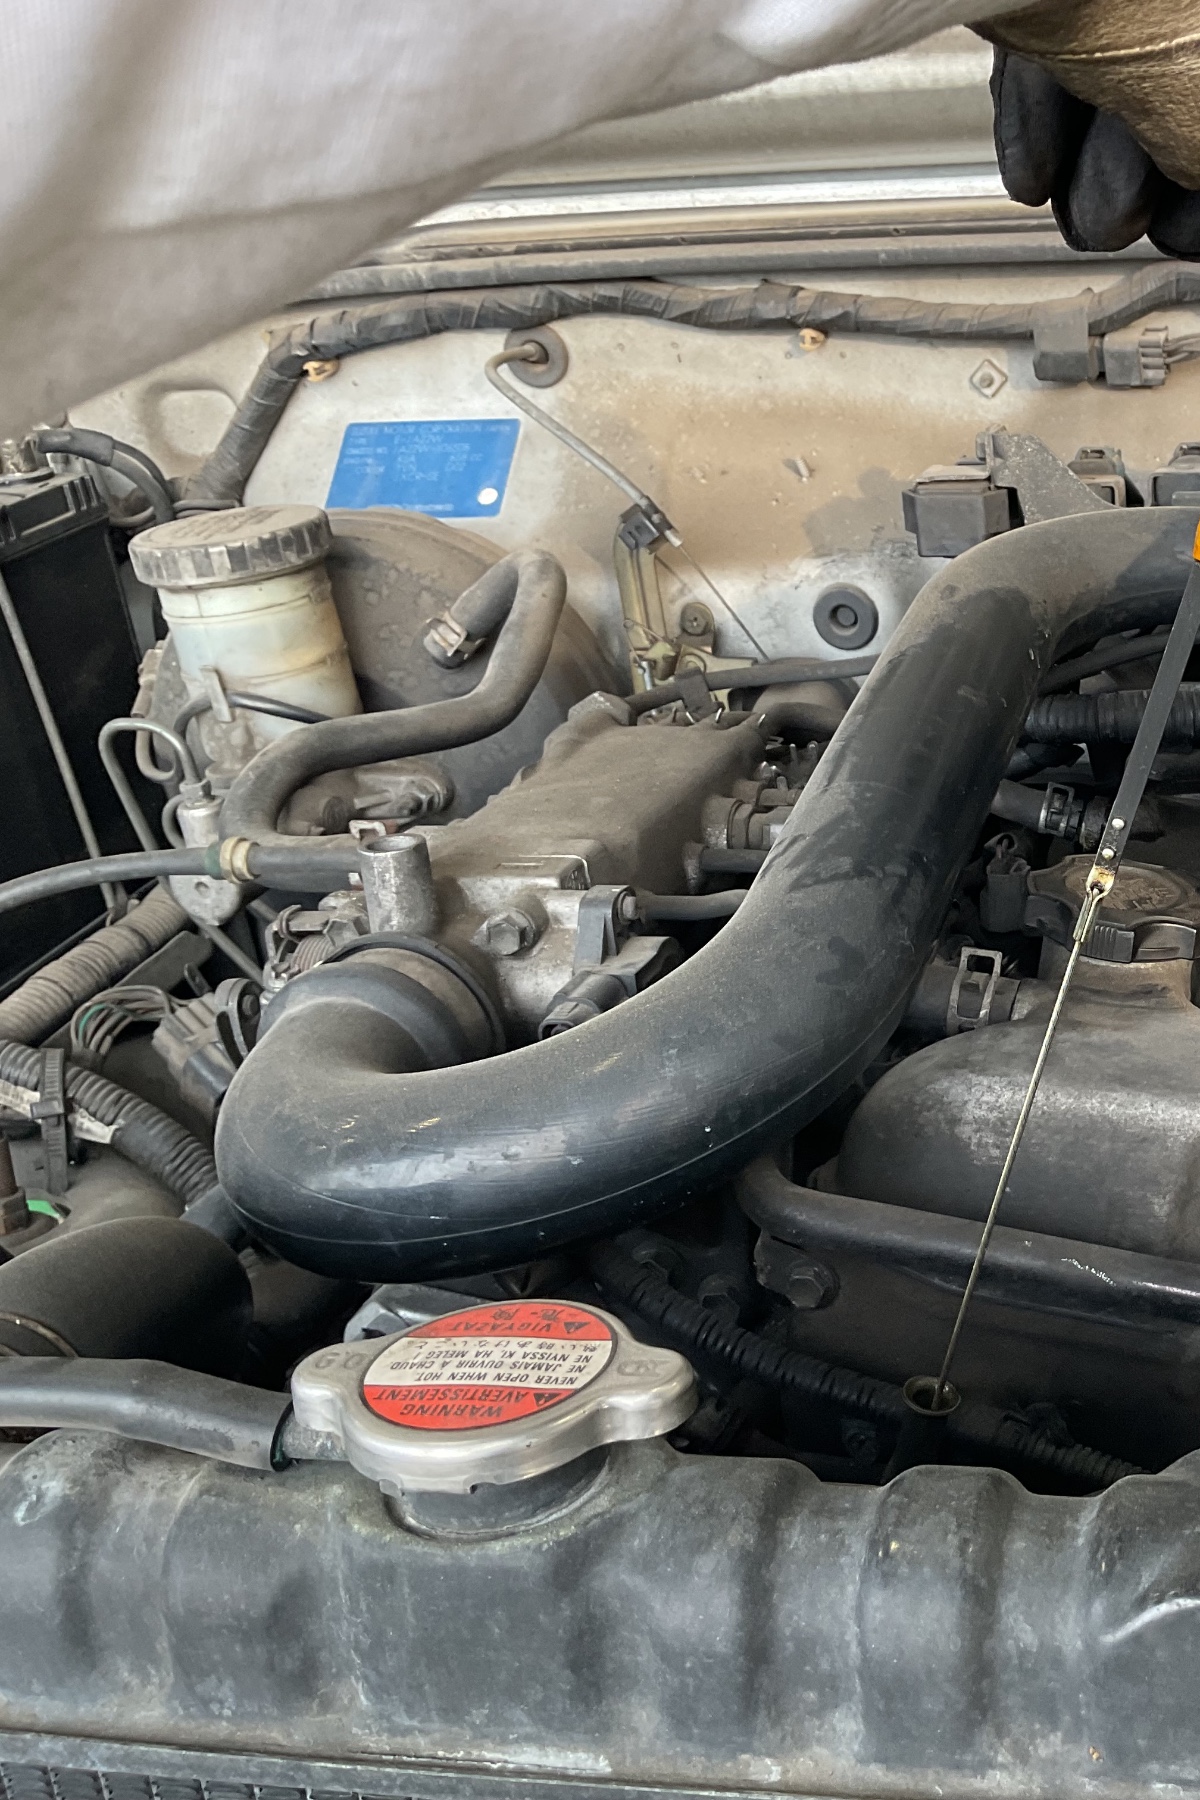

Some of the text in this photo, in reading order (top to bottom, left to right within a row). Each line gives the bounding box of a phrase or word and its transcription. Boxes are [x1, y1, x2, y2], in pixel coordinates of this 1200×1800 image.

[425, 1350, 468, 1360] MELEG
[474, 1350, 492, 1359] HA
[522, 1351, 570, 1362] NYISSA
[574, 1354, 593, 1364] NE
[390, 1359, 587, 1374] NE JAMAIS OUVRIR À CHAUD.
[414, 1371, 579, 1386] NEVER OPEN WHEN HOT.
[373, 1388, 530, 1404] AVERTISSEMENT
[399, 1404, 505, 1418] WARNING
